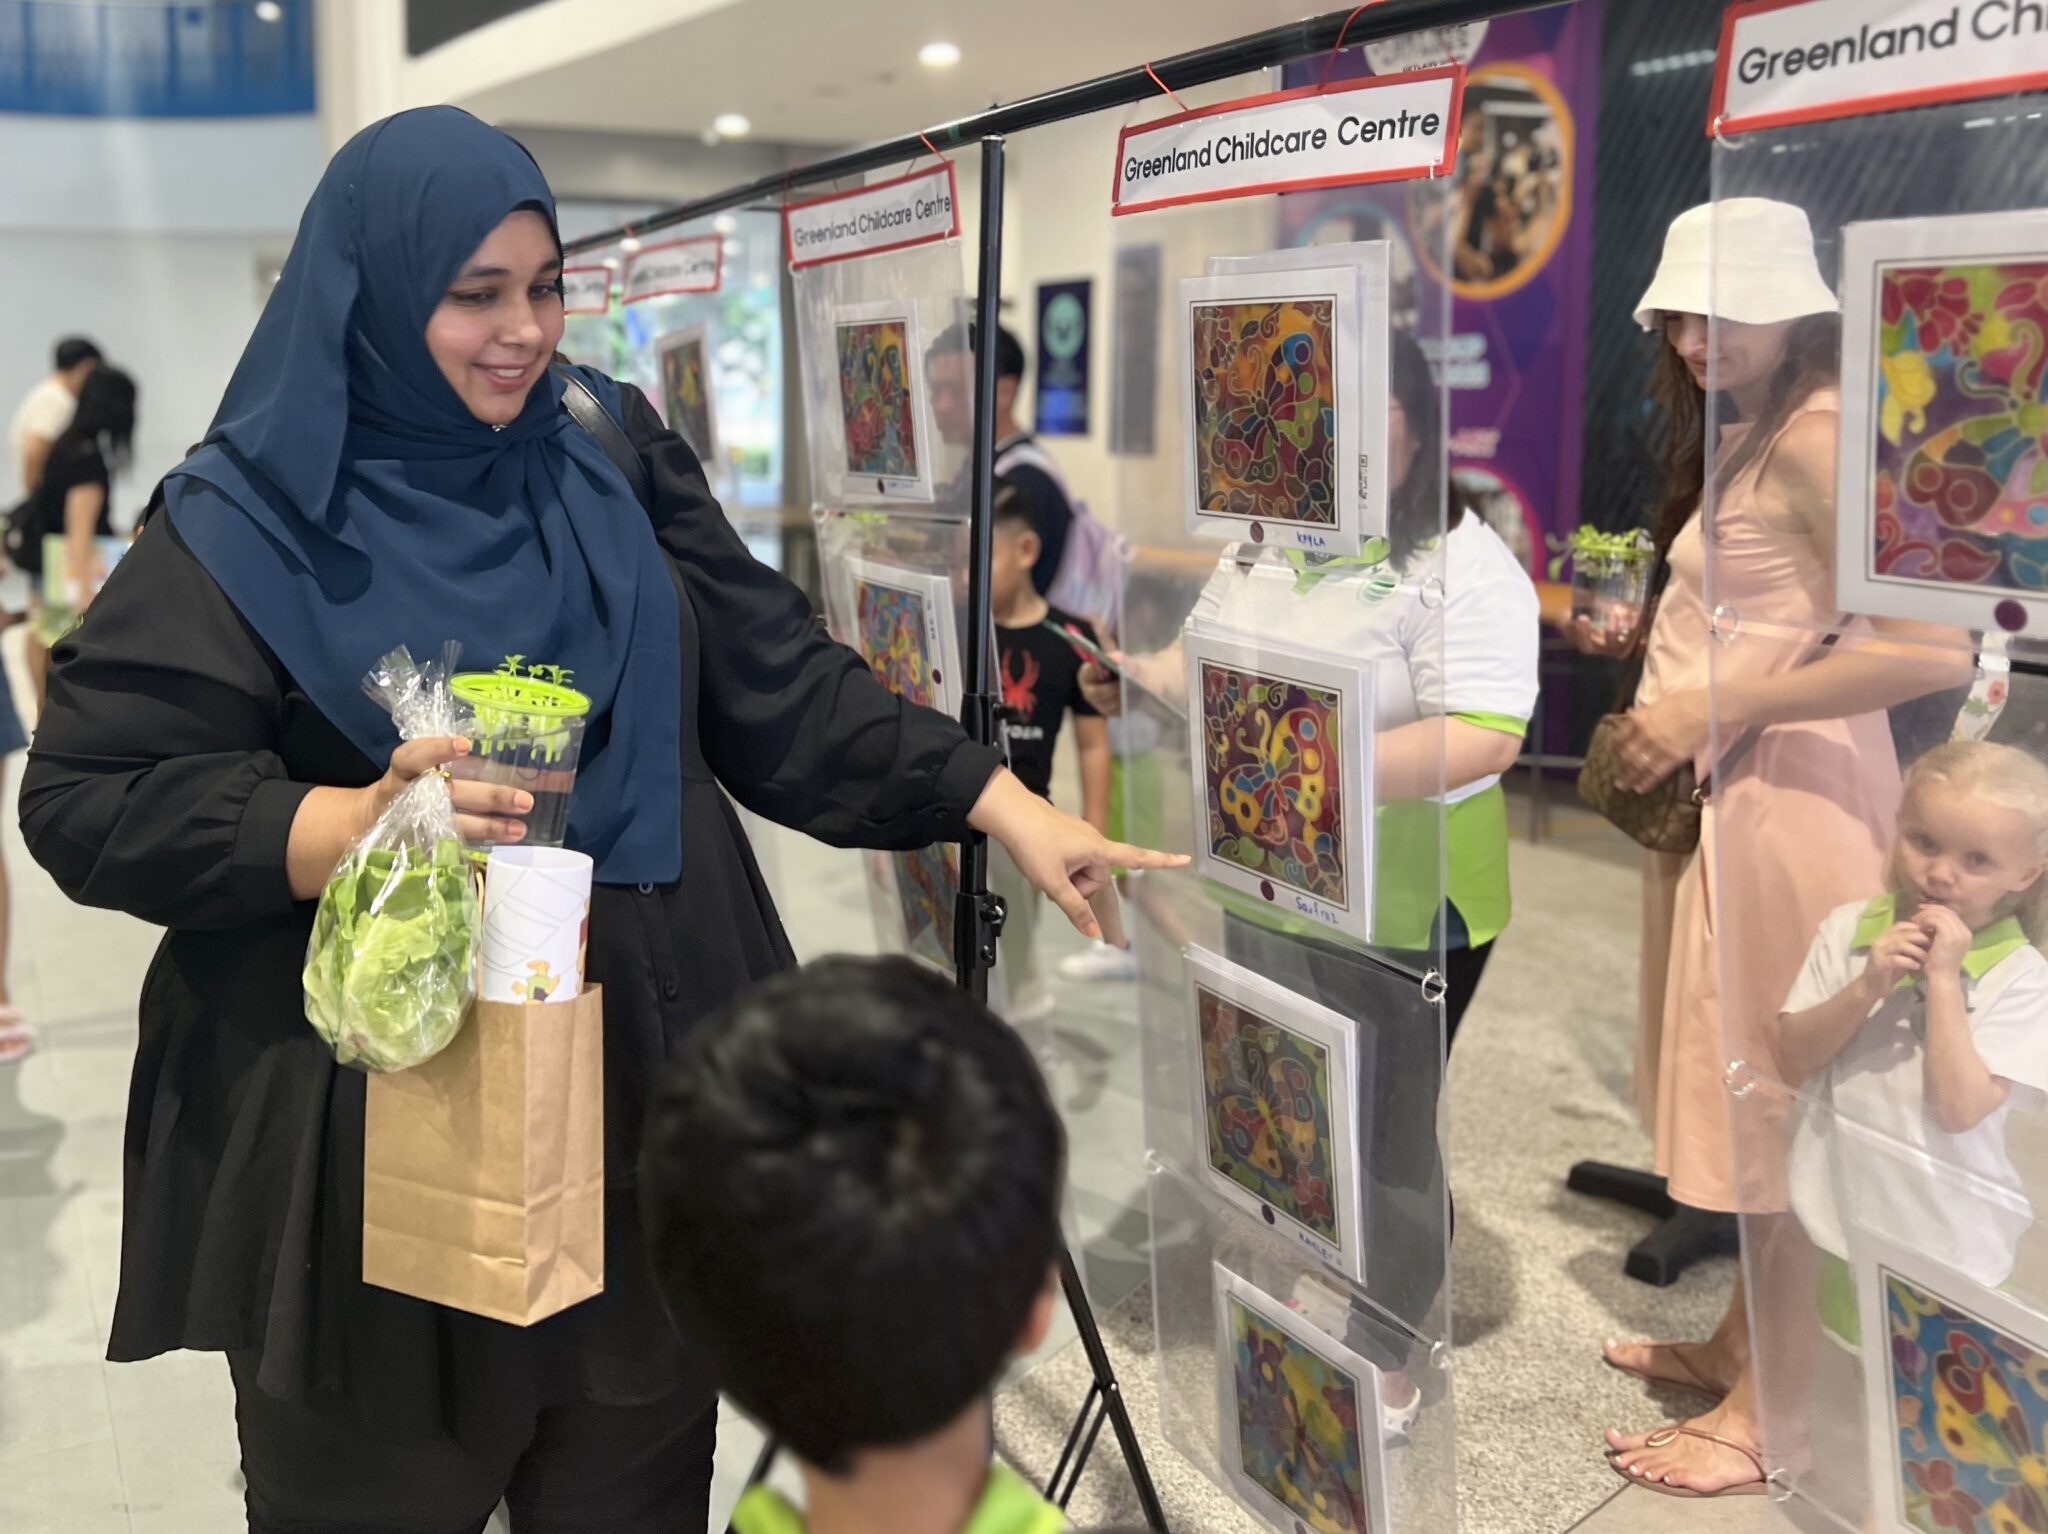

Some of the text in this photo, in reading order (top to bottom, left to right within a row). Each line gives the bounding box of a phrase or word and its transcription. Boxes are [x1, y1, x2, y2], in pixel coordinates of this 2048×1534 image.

[1738, 0, 2048, 84] Greenland Ch
[1124, 109, 1440, 182] Greenland Childcare Centre
[794, 194, 950, 247] Greenland Childcare Centre
